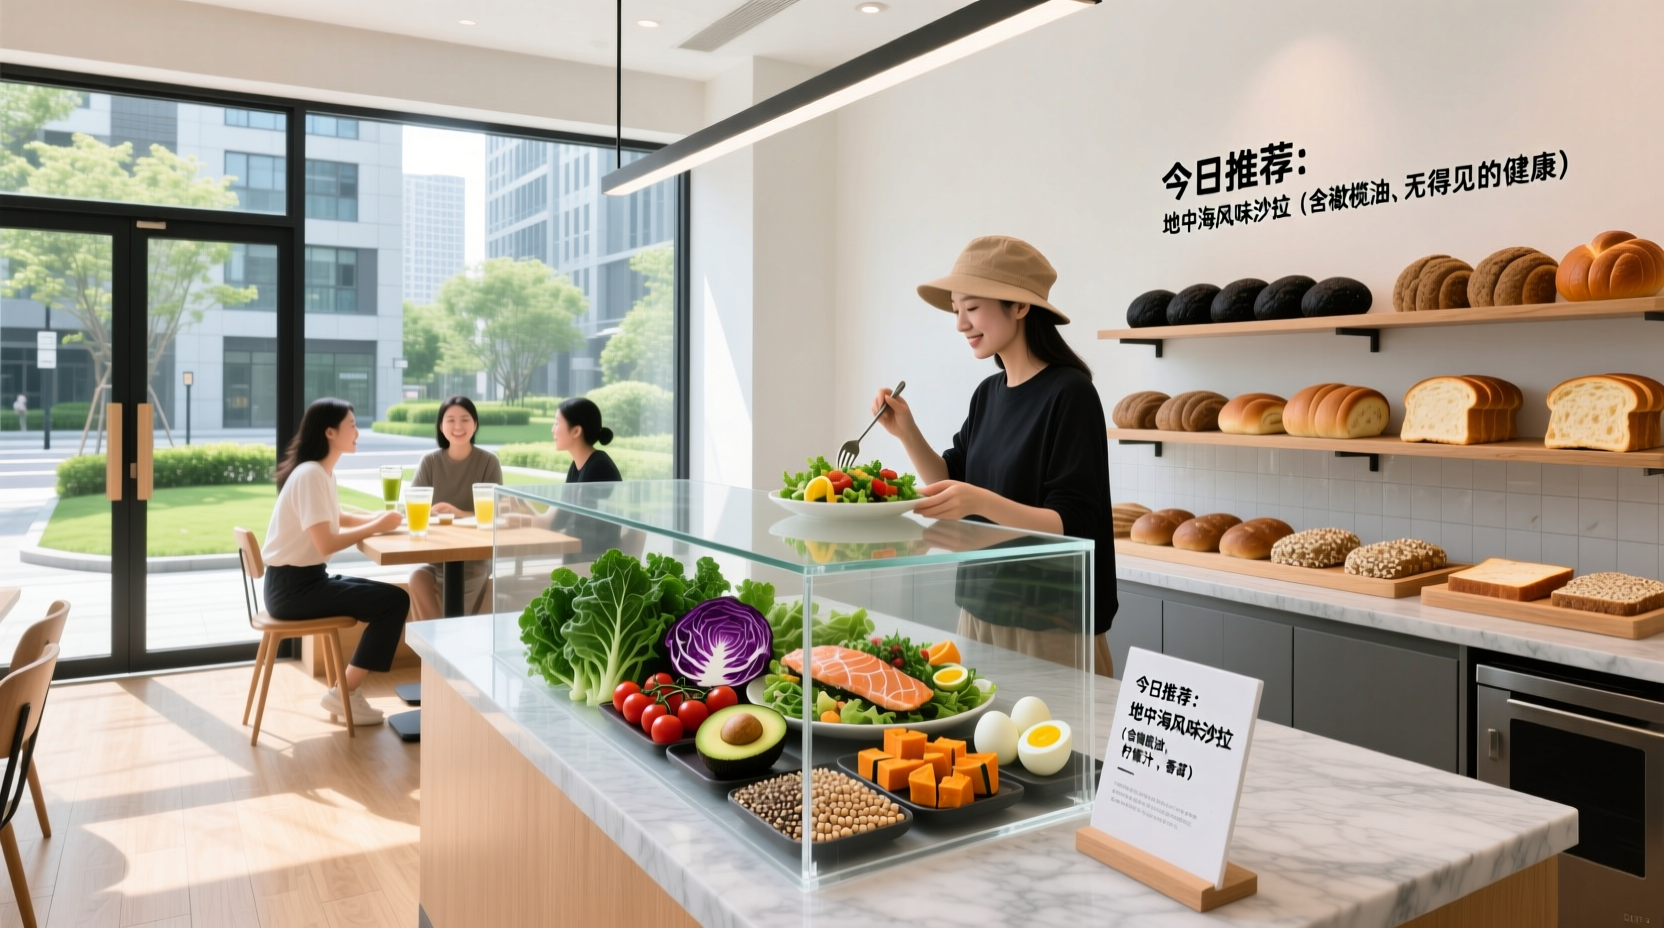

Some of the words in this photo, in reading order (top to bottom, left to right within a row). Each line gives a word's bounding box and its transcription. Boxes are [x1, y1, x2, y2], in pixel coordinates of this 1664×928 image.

[1161, 141, 1307, 201] 今日推荐：
[1135, 675, 1200, 708] 今日推荐：
[1128, 701, 1235, 751] 地中海风味沙拉
